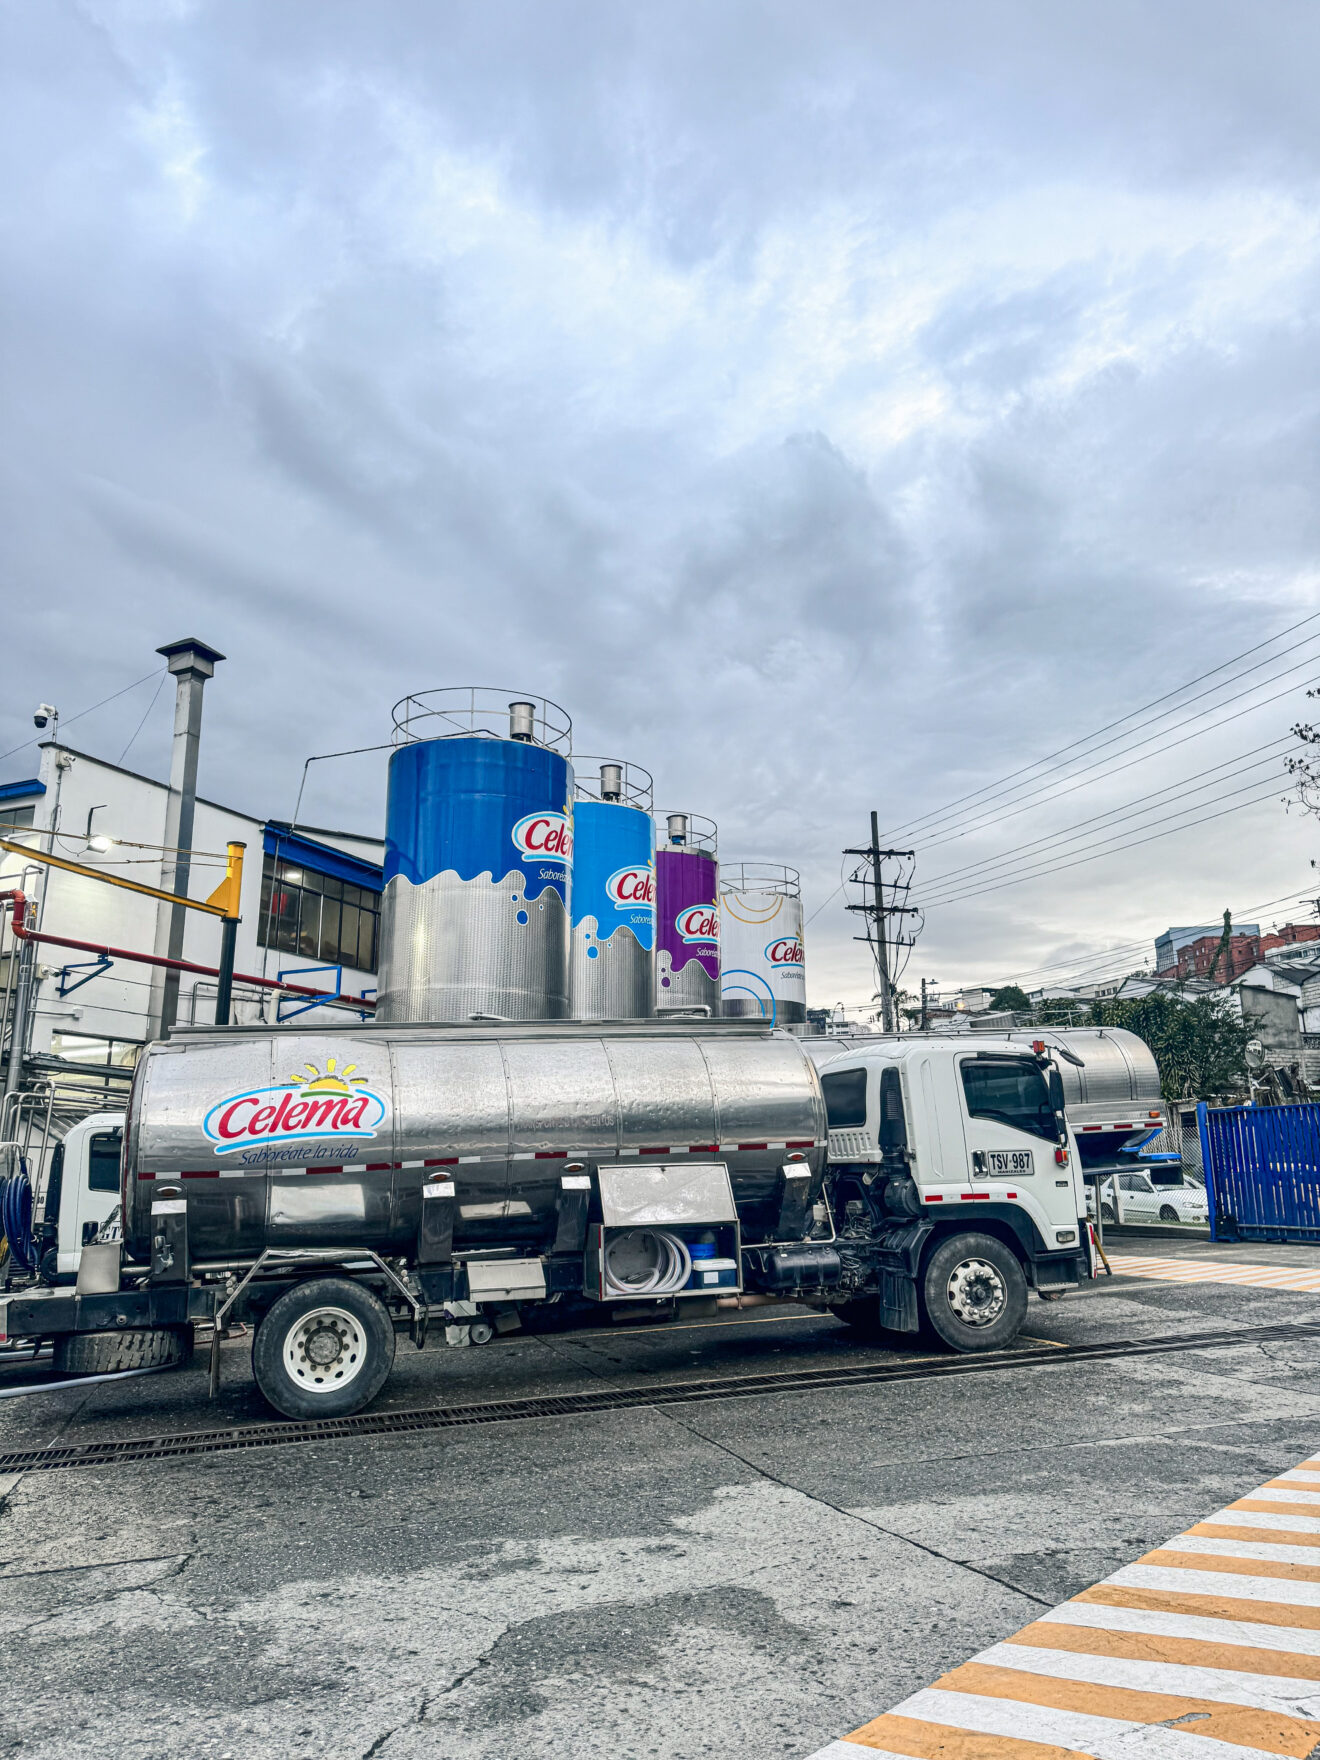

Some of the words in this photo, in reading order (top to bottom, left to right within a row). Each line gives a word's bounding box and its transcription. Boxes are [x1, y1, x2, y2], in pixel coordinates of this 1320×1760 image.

[218, 1093, 369, 1139] Celema
[238, 1146, 312, 1166] Saboréate
[312, 1144, 328, 1159] la
[329, 1144, 359, 1159] vida
